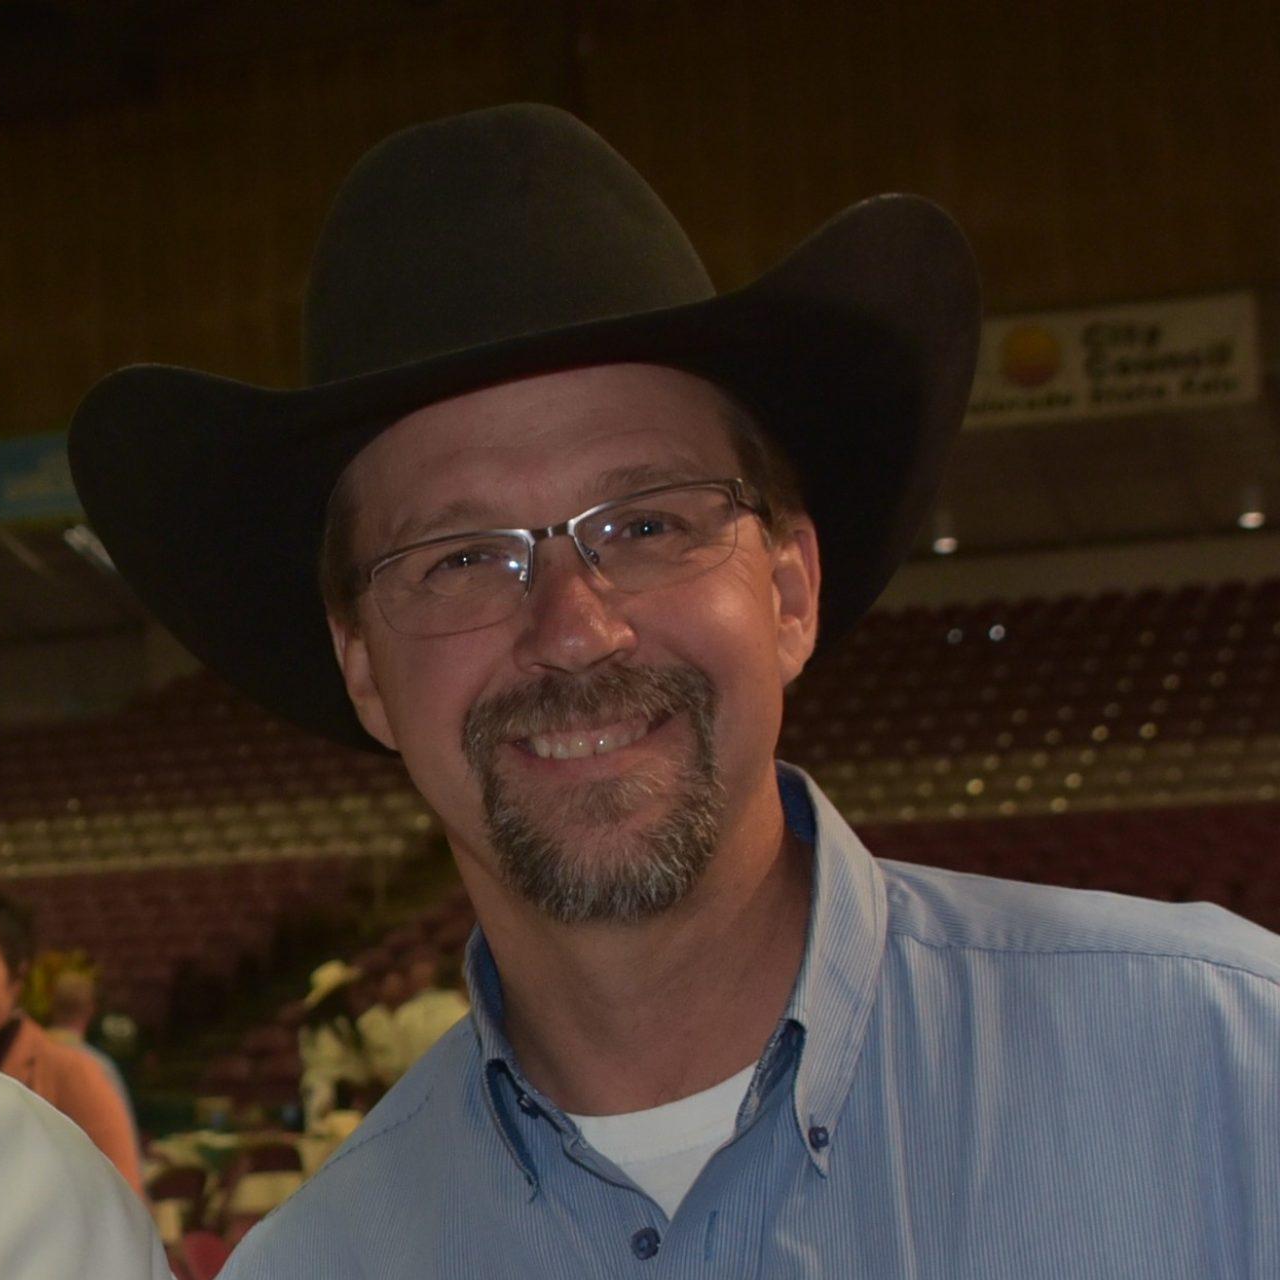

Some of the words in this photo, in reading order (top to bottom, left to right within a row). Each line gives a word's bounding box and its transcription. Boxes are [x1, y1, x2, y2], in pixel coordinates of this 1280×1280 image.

[1080, 321, 1162, 350] City
[1080, 338, 1235, 380] Council
[967, 393, 1071, 413] olorado
